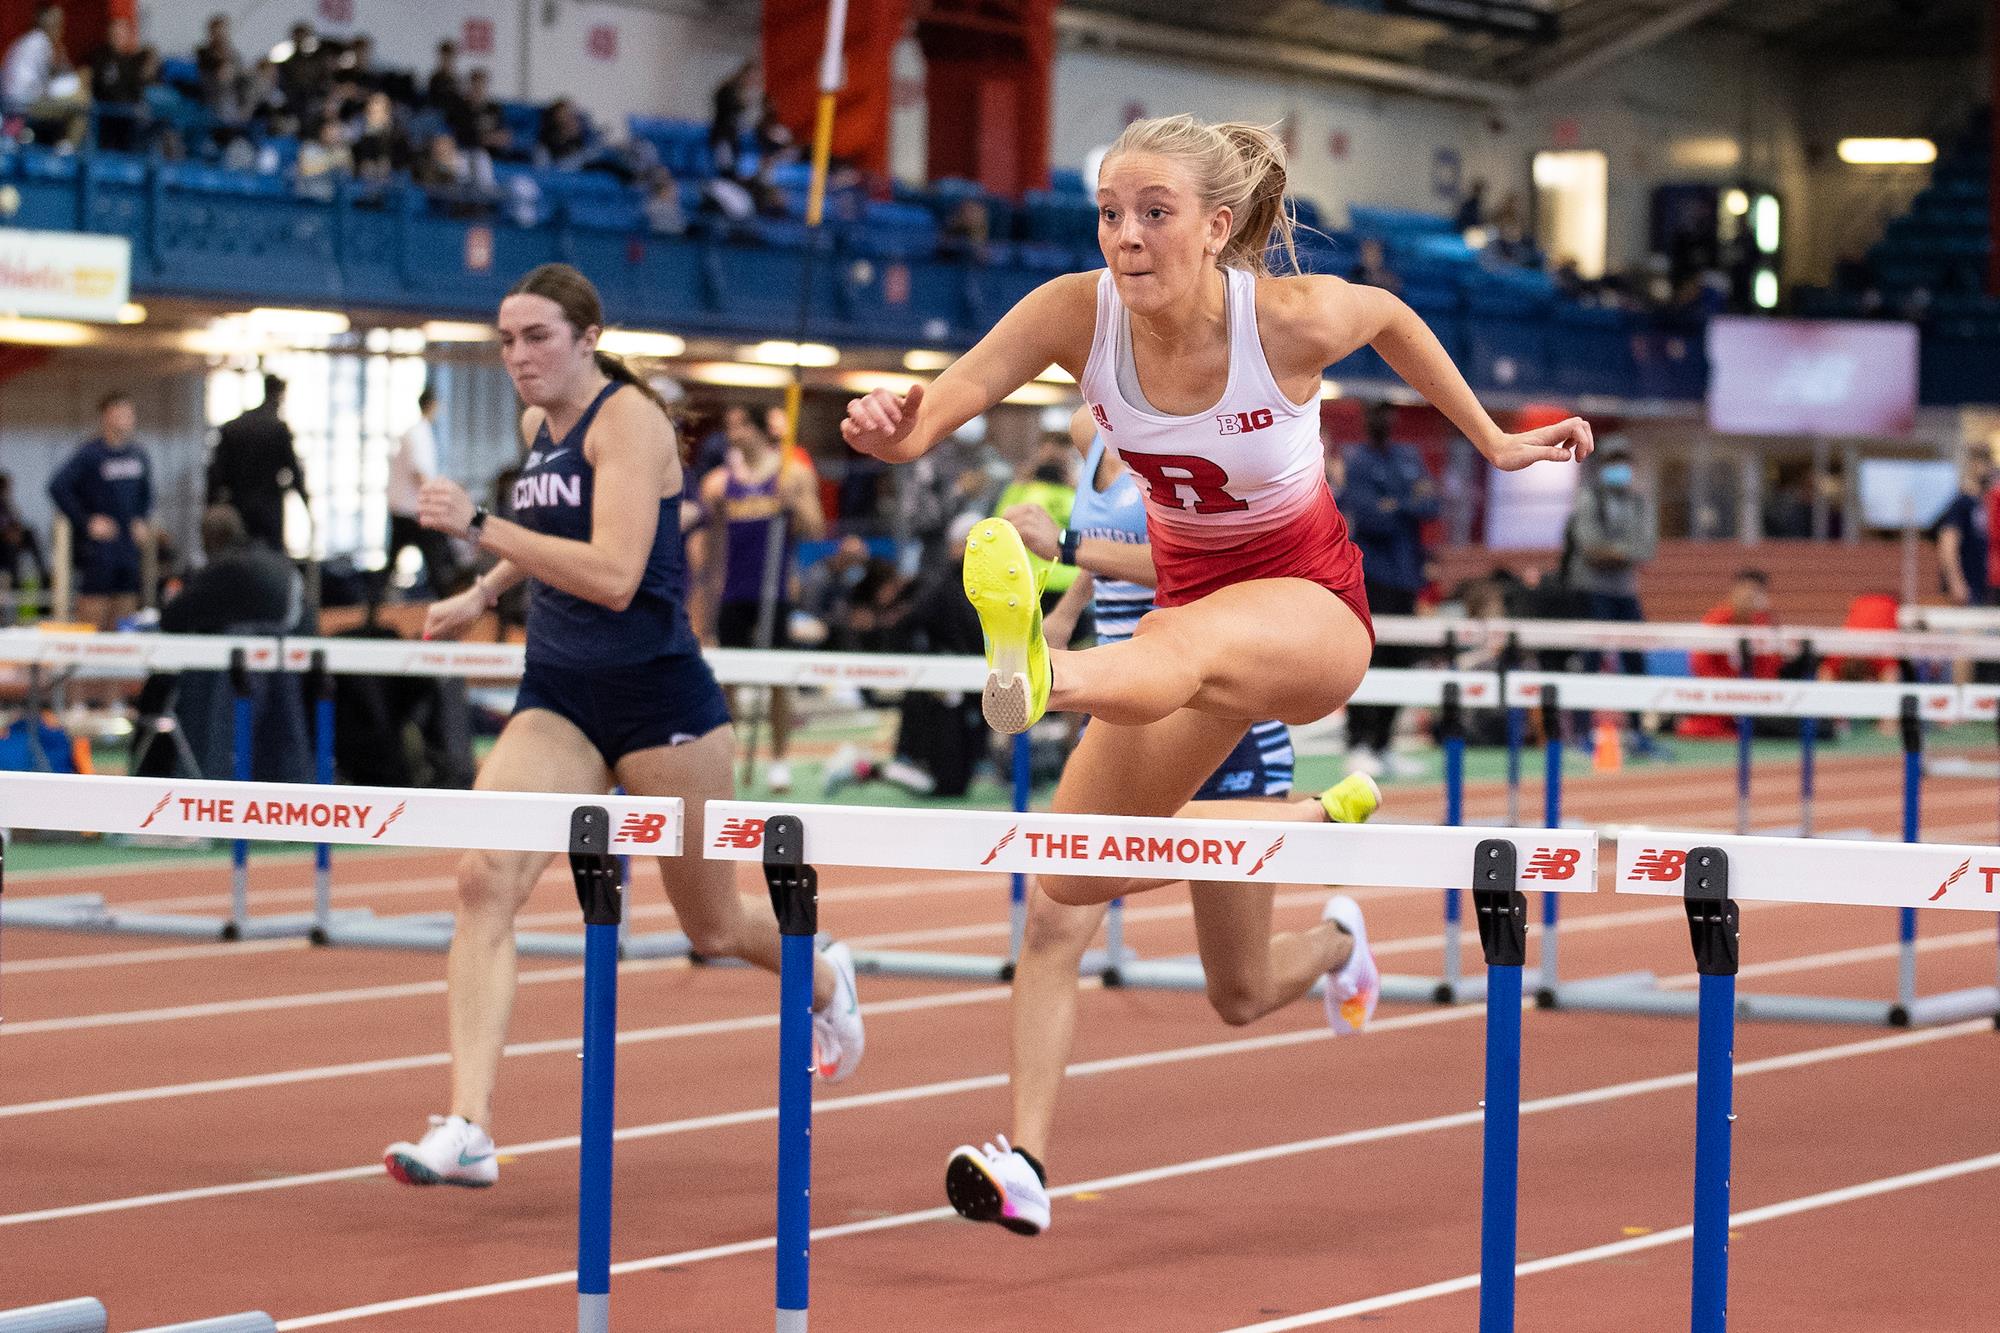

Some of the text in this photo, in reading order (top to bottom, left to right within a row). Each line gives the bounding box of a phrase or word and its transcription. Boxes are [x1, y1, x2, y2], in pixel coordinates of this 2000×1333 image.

[1117, 447, 1250, 515] R
[178, 798, 371, 829] THE ARMORY
[1025, 832, 1246, 865] THE ARMORY
